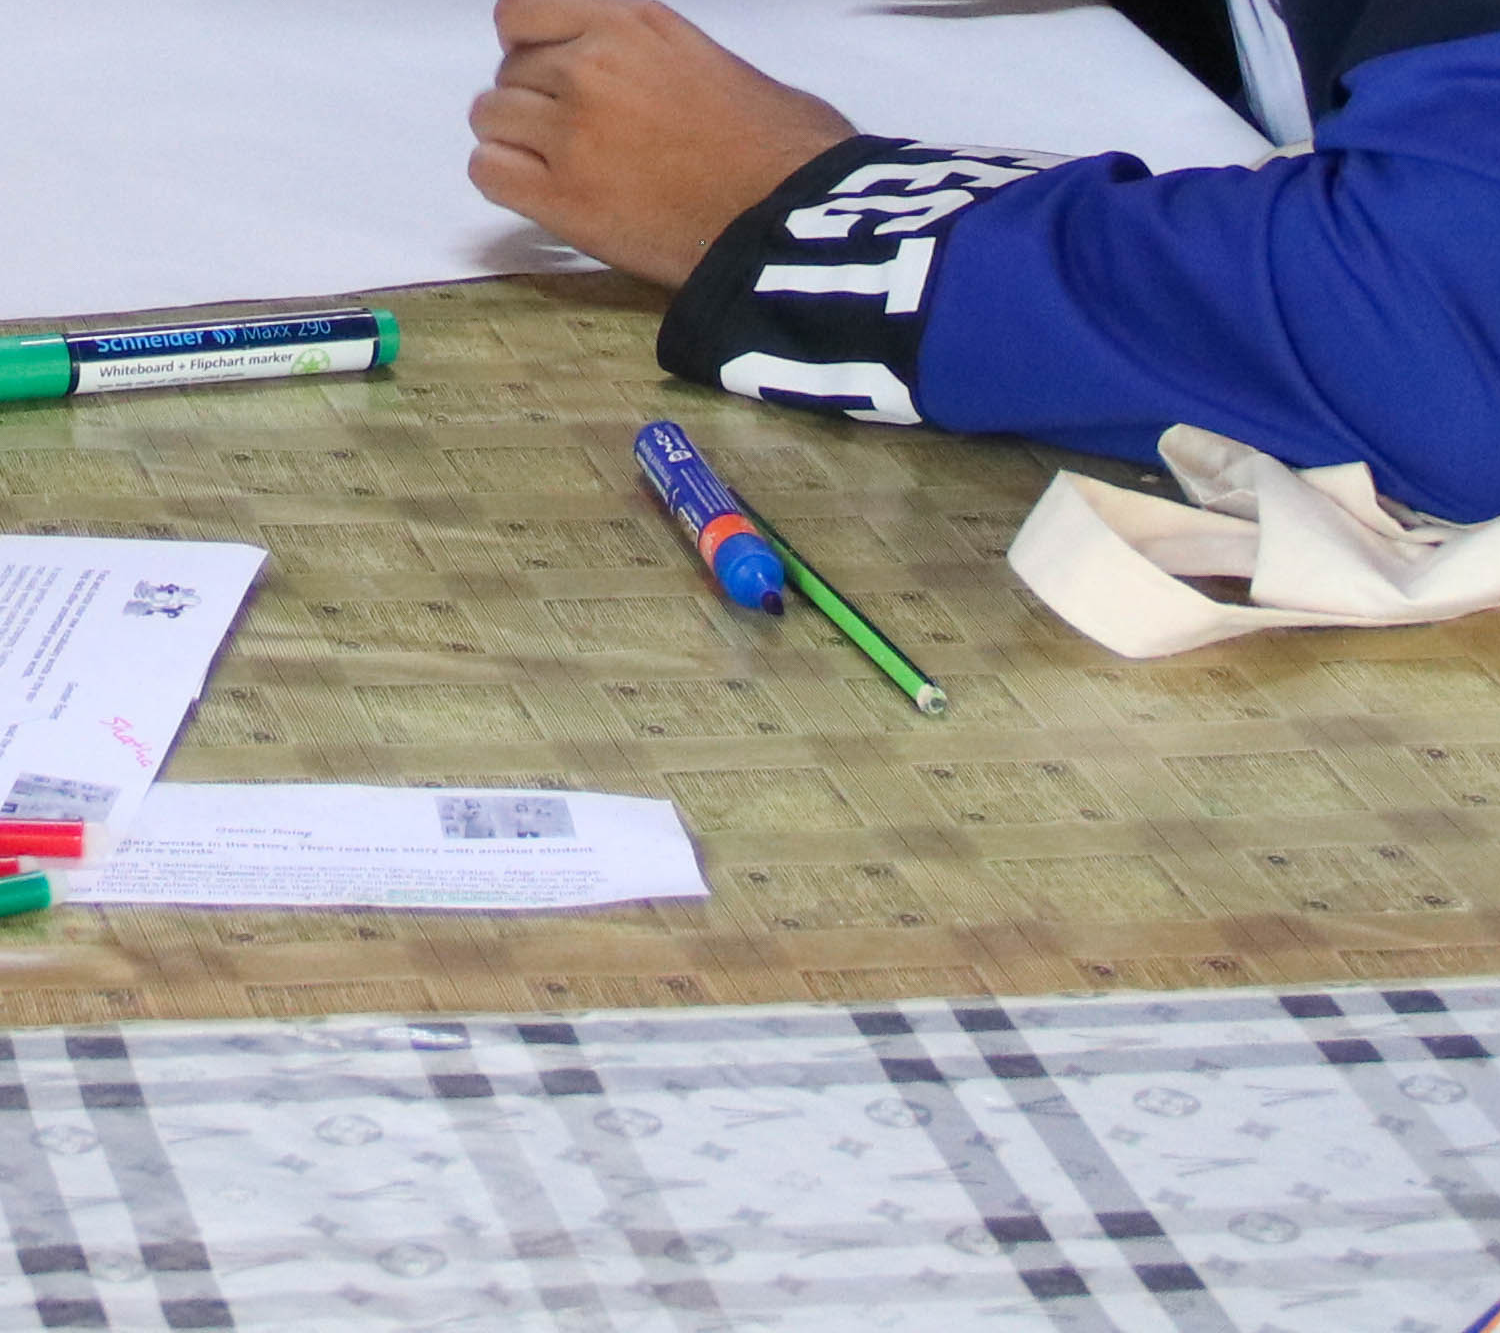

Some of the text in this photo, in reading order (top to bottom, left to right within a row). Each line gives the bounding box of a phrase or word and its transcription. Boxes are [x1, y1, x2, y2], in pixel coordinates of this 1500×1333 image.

[99, 360, 175, 379] Whiteboard
[190, 354, 245, 375] Flipchart
[248, 350, 294, 367] marker
